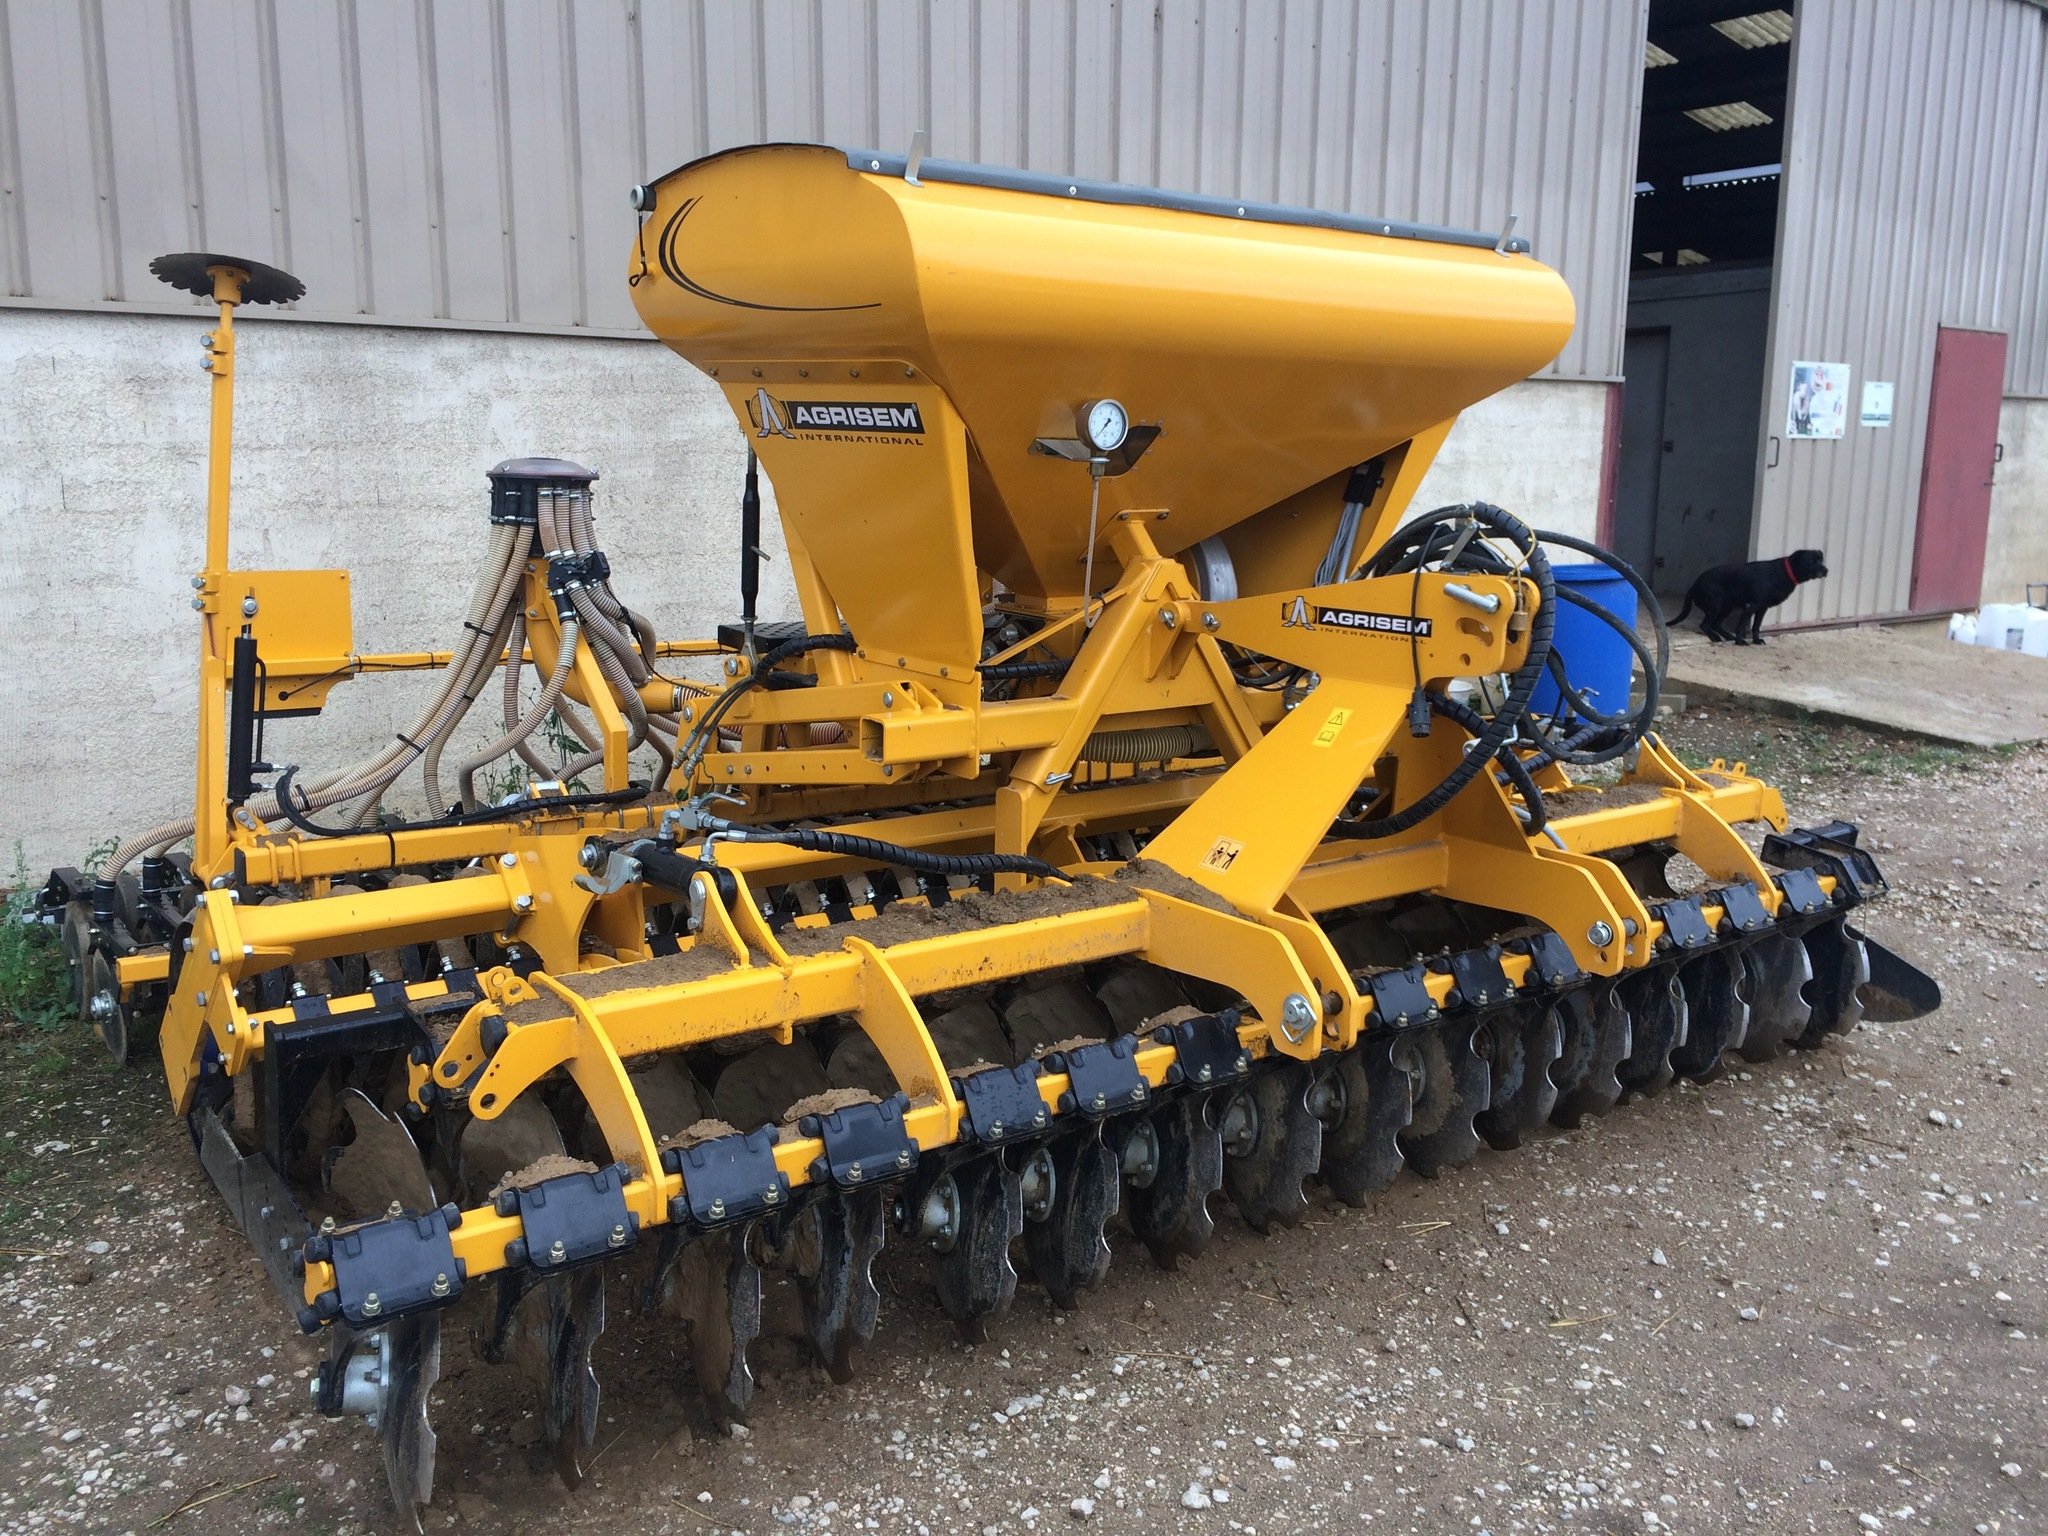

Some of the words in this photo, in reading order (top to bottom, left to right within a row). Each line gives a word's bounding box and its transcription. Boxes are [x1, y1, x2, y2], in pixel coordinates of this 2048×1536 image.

[796, 405, 918, 428] AGRISEM
[800, 434, 924, 446] INTERNATIONAL
[1321, 611, 1428, 634] AGRISEM
